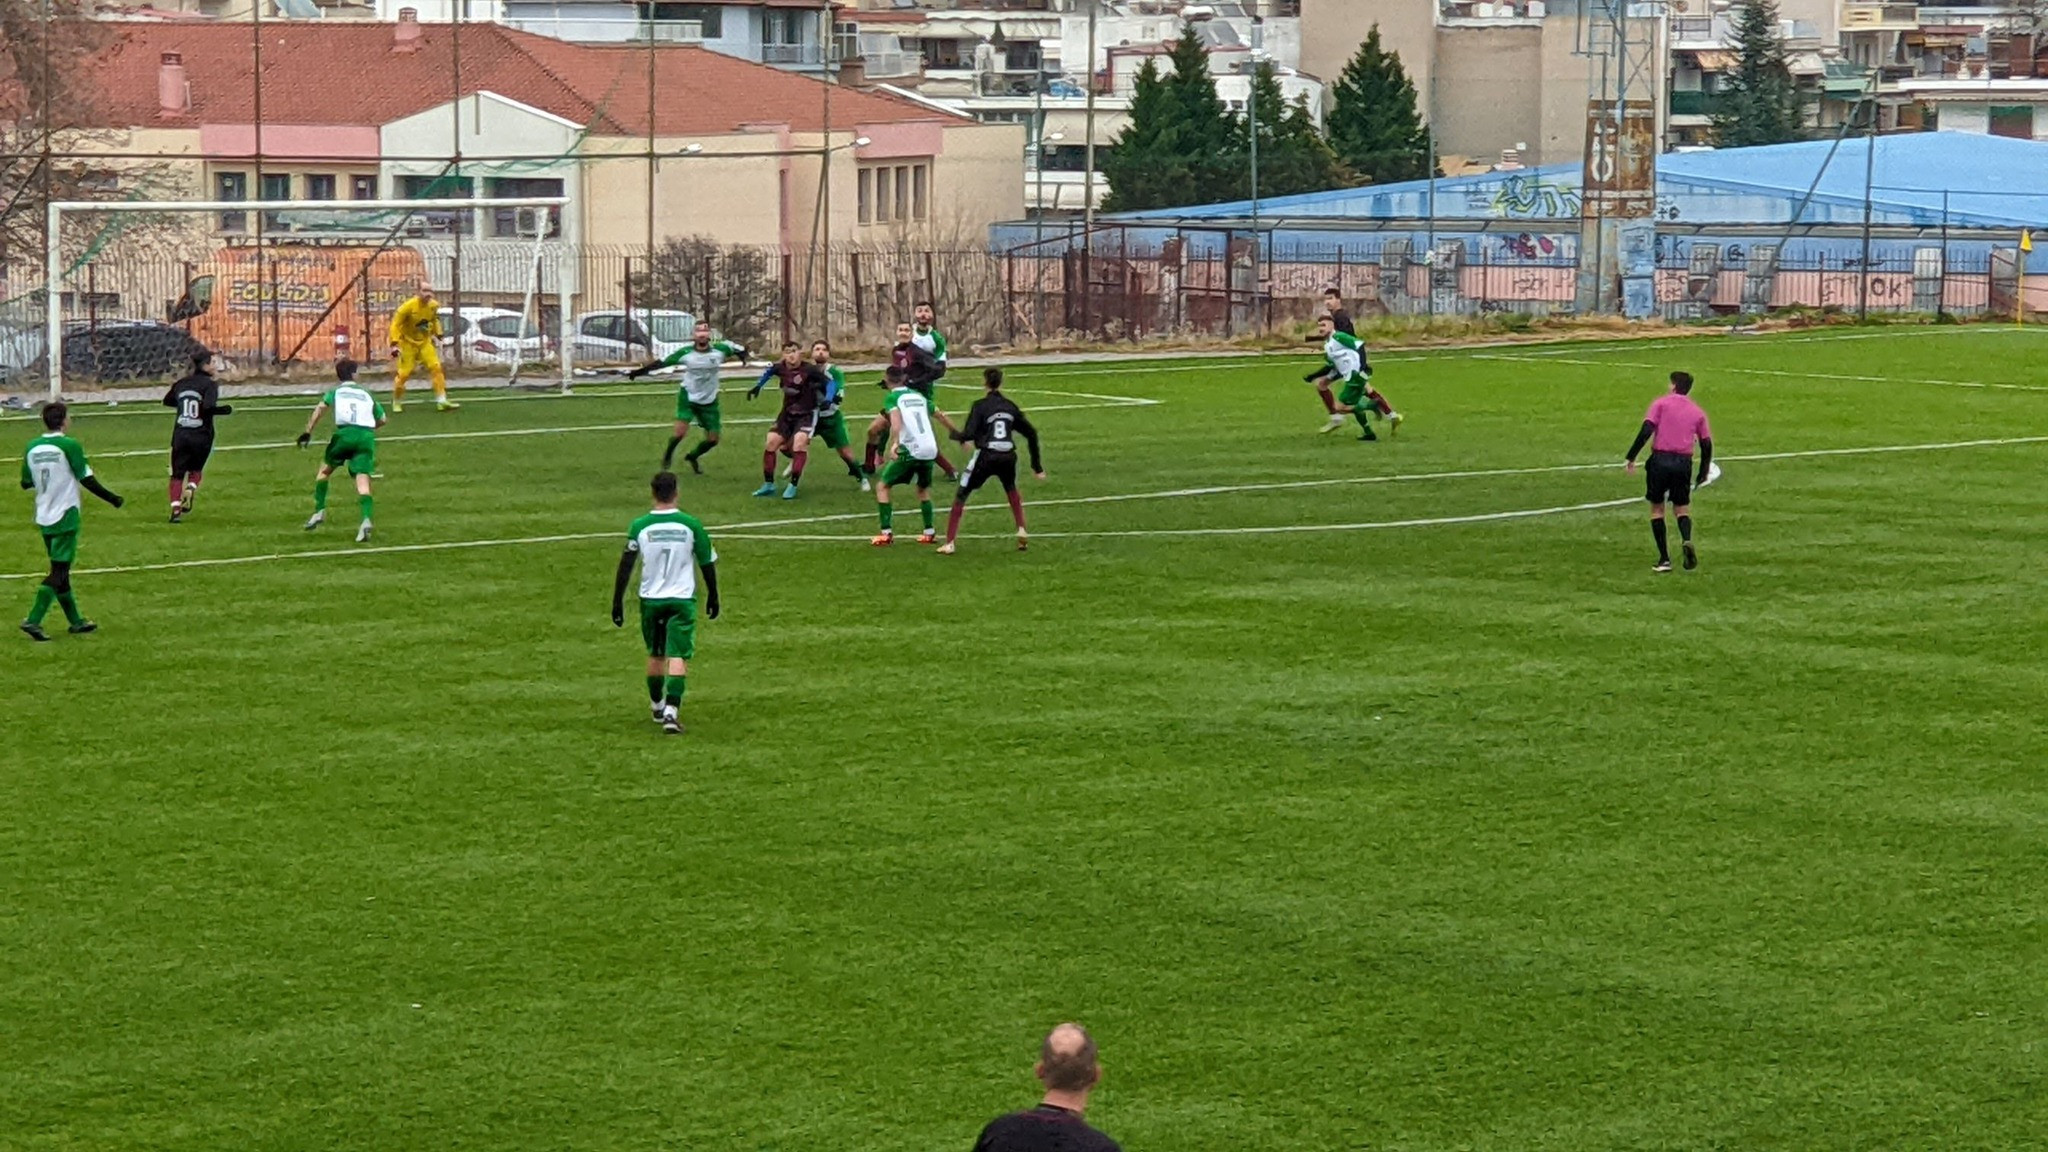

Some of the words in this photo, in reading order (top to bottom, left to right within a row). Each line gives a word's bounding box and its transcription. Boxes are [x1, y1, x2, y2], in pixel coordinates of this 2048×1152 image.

[183, 398, 199, 418] 10
[994, 420, 1007, 439] 8
[661, 548, 672, 579] 7
